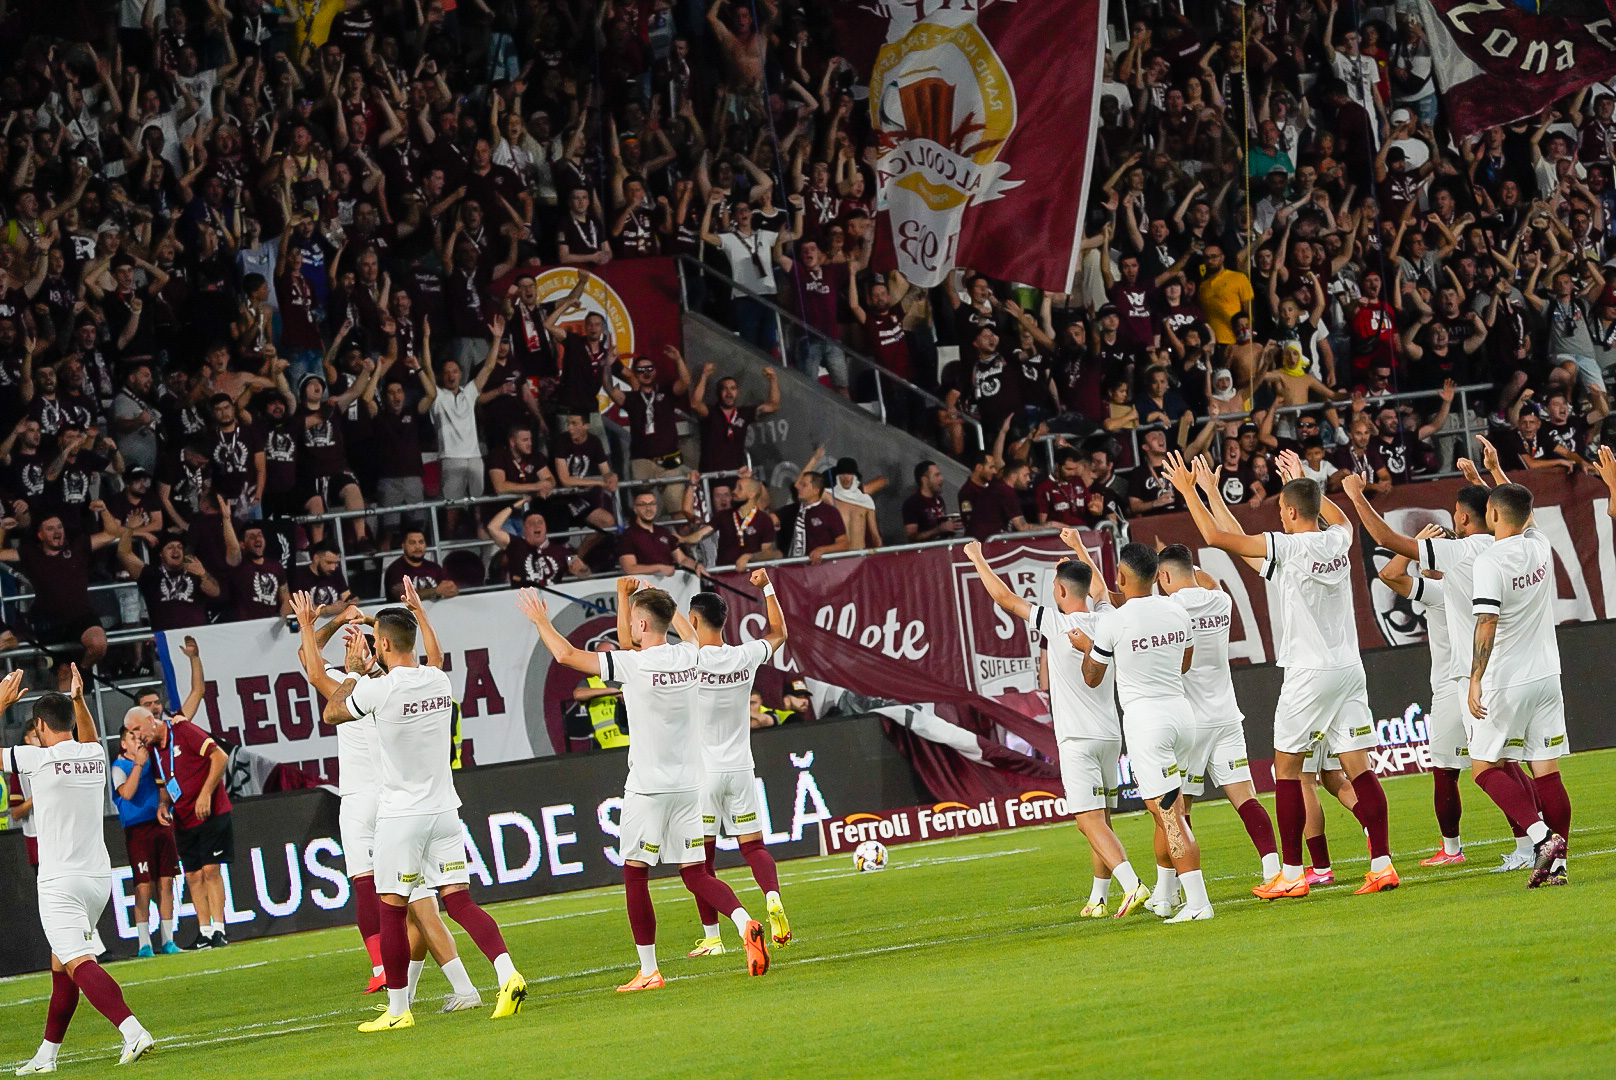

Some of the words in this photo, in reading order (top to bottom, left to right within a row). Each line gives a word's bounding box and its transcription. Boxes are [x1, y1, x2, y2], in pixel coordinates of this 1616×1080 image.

[1512, 576, 1525, 591] FC
[1199, 614, 1230, 630] RAPID
[1131, 637, 1149, 652] FC
[1151, 630, 1185, 648] RAPID
[652, 673, 668, 687] FC
[670, 667, 698, 685] RAPID
[700, 672, 716, 685] FC
[718, 668, 750, 685] RAPID
[980, 658, 1032, 680] SUFLETE
[402, 702, 418, 716] FC
[421, 695, 452, 713] RAPID
[54, 762, 72, 775] FC
[74, 760, 104, 775] RAPID
[829, 813, 911, 850] Ferroli
[917, 801, 999, 839] Ferroli
[1005, 796, 1069, 828] Ferro
[137, 861, 149, 874] 14
